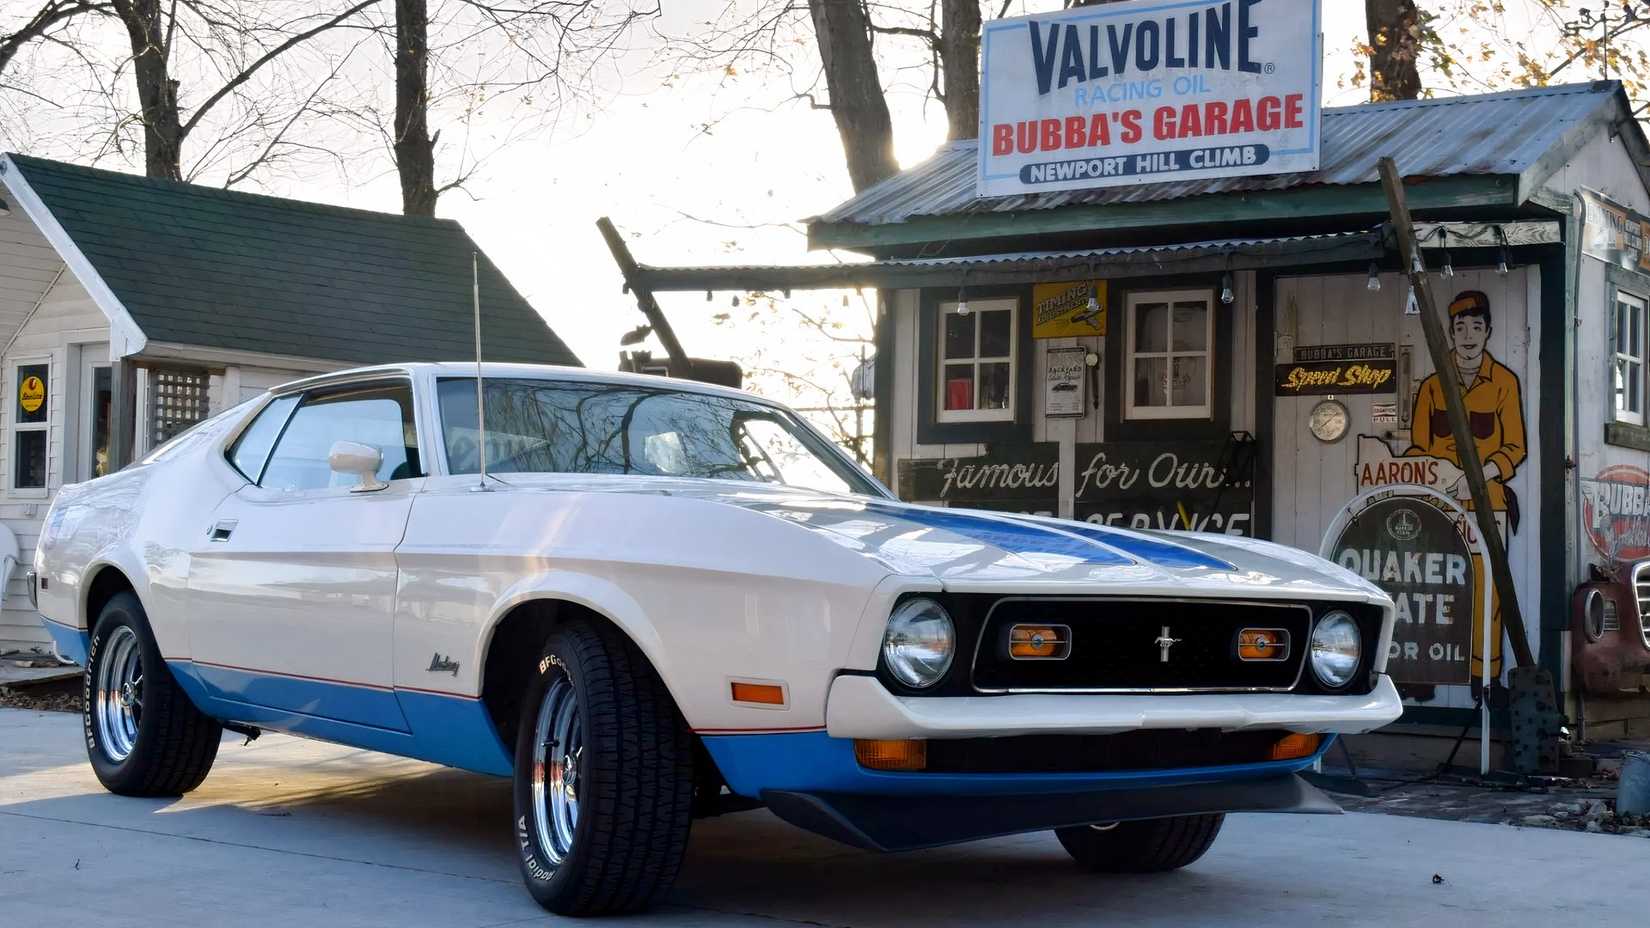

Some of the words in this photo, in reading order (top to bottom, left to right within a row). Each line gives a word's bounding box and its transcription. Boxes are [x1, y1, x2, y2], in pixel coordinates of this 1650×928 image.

[1028, 0, 1262, 96] VALVOLINE
[1074, 77, 1163, 107] RACING
[1173, 74, 1211, 95] OIL
[992, 109, 1143, 156] BUBBA'S
[1154, 93, 1304, 140] GARAGE
[1030, 157, 1128, 183] NEWPORT
[1136, 151, 1180, 173] HILL
[1190, 147, 1256, 169] CLIMB
[1349, 346, 1385, 358] GARAGE
[1281, 366, 1341, 391] Speed
[1337, 364, 1392, 389] Shop
[937, 459, 1059, 497] Famous
[1076, 452, 1139, 498] for
[1360, 461, 1439, 486] AARON'S
[1338, 548, 1467, 585] QUAKER
[1390, 592, 1456, 625] ATE
[1429, 642, 1465, 661] OIL
